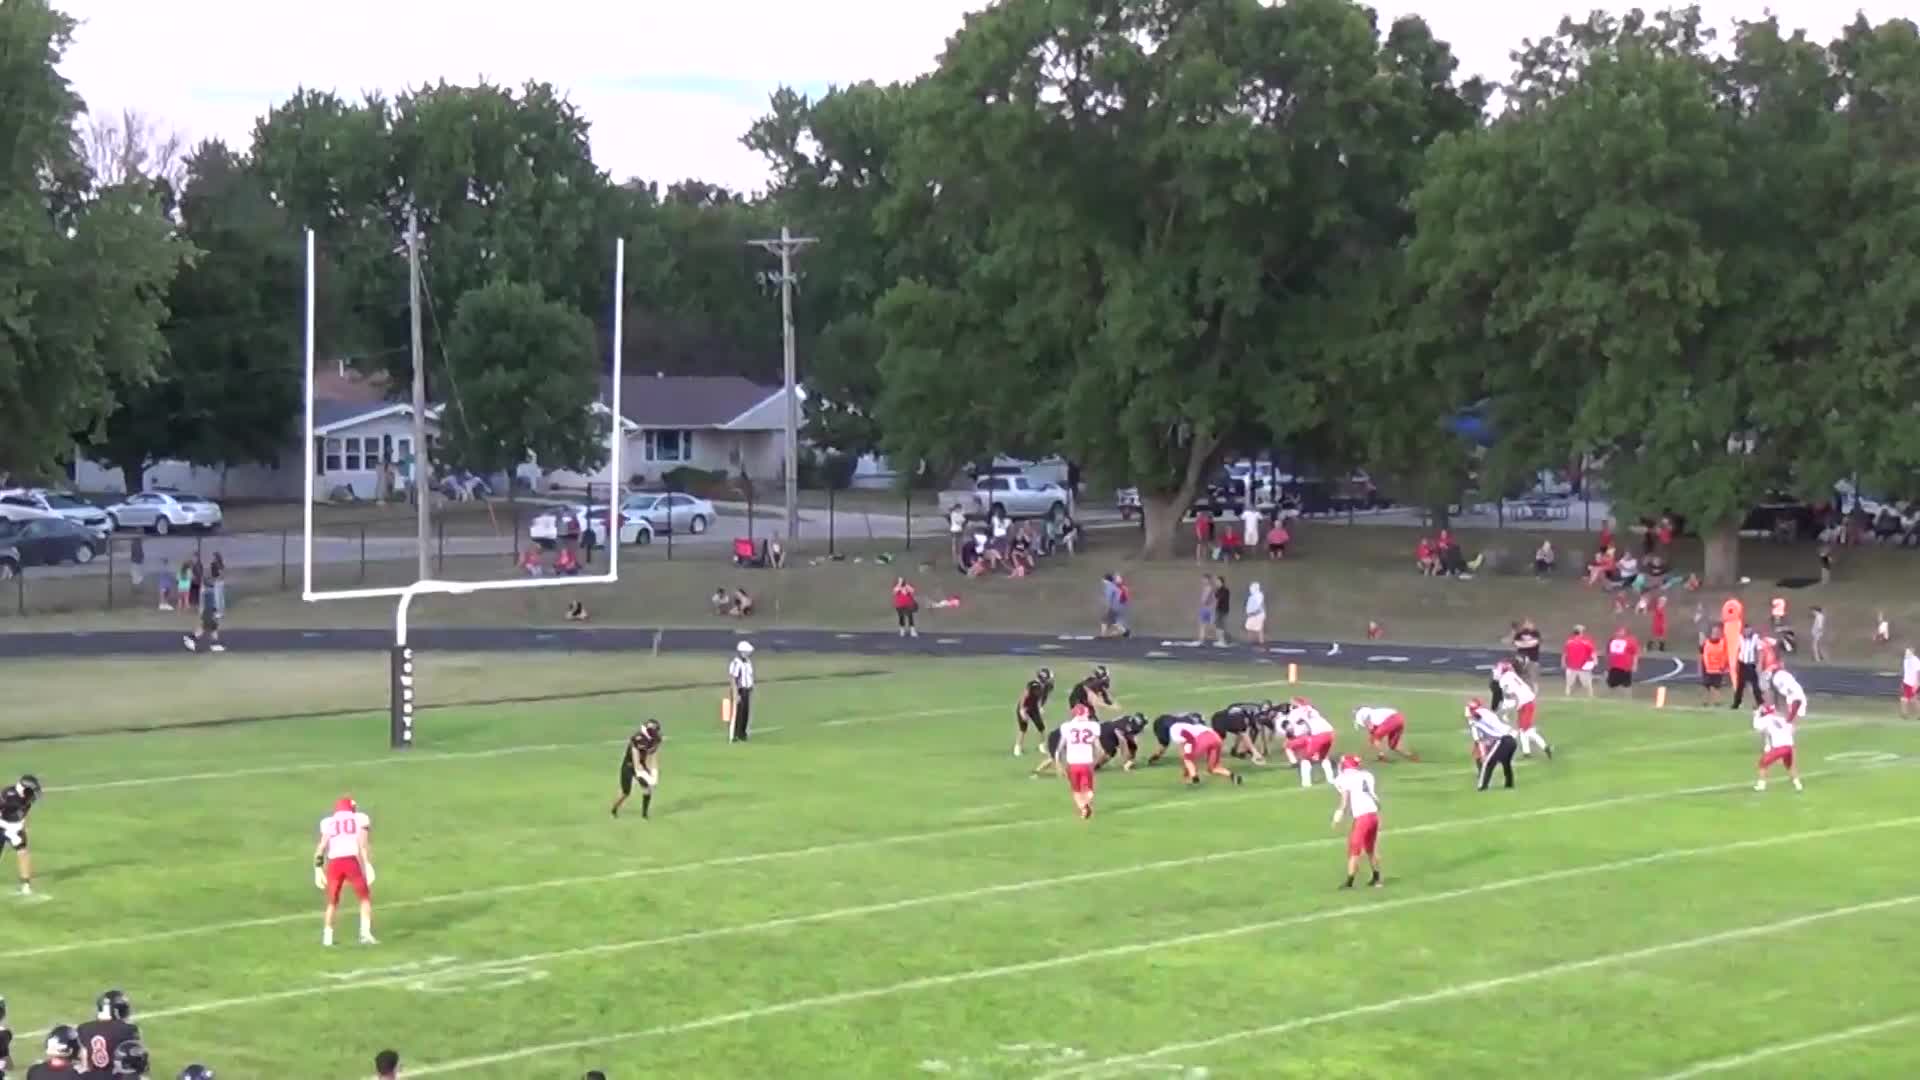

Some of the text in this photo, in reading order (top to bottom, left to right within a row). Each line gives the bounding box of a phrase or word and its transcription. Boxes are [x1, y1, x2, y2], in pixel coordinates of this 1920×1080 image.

[1771, 598, 1785, 616] 2
[401, 648, 412, 741] COWBOYS
[1070, 727, 1094, 745] 32
[90, 1034, 109, 1068] 8
